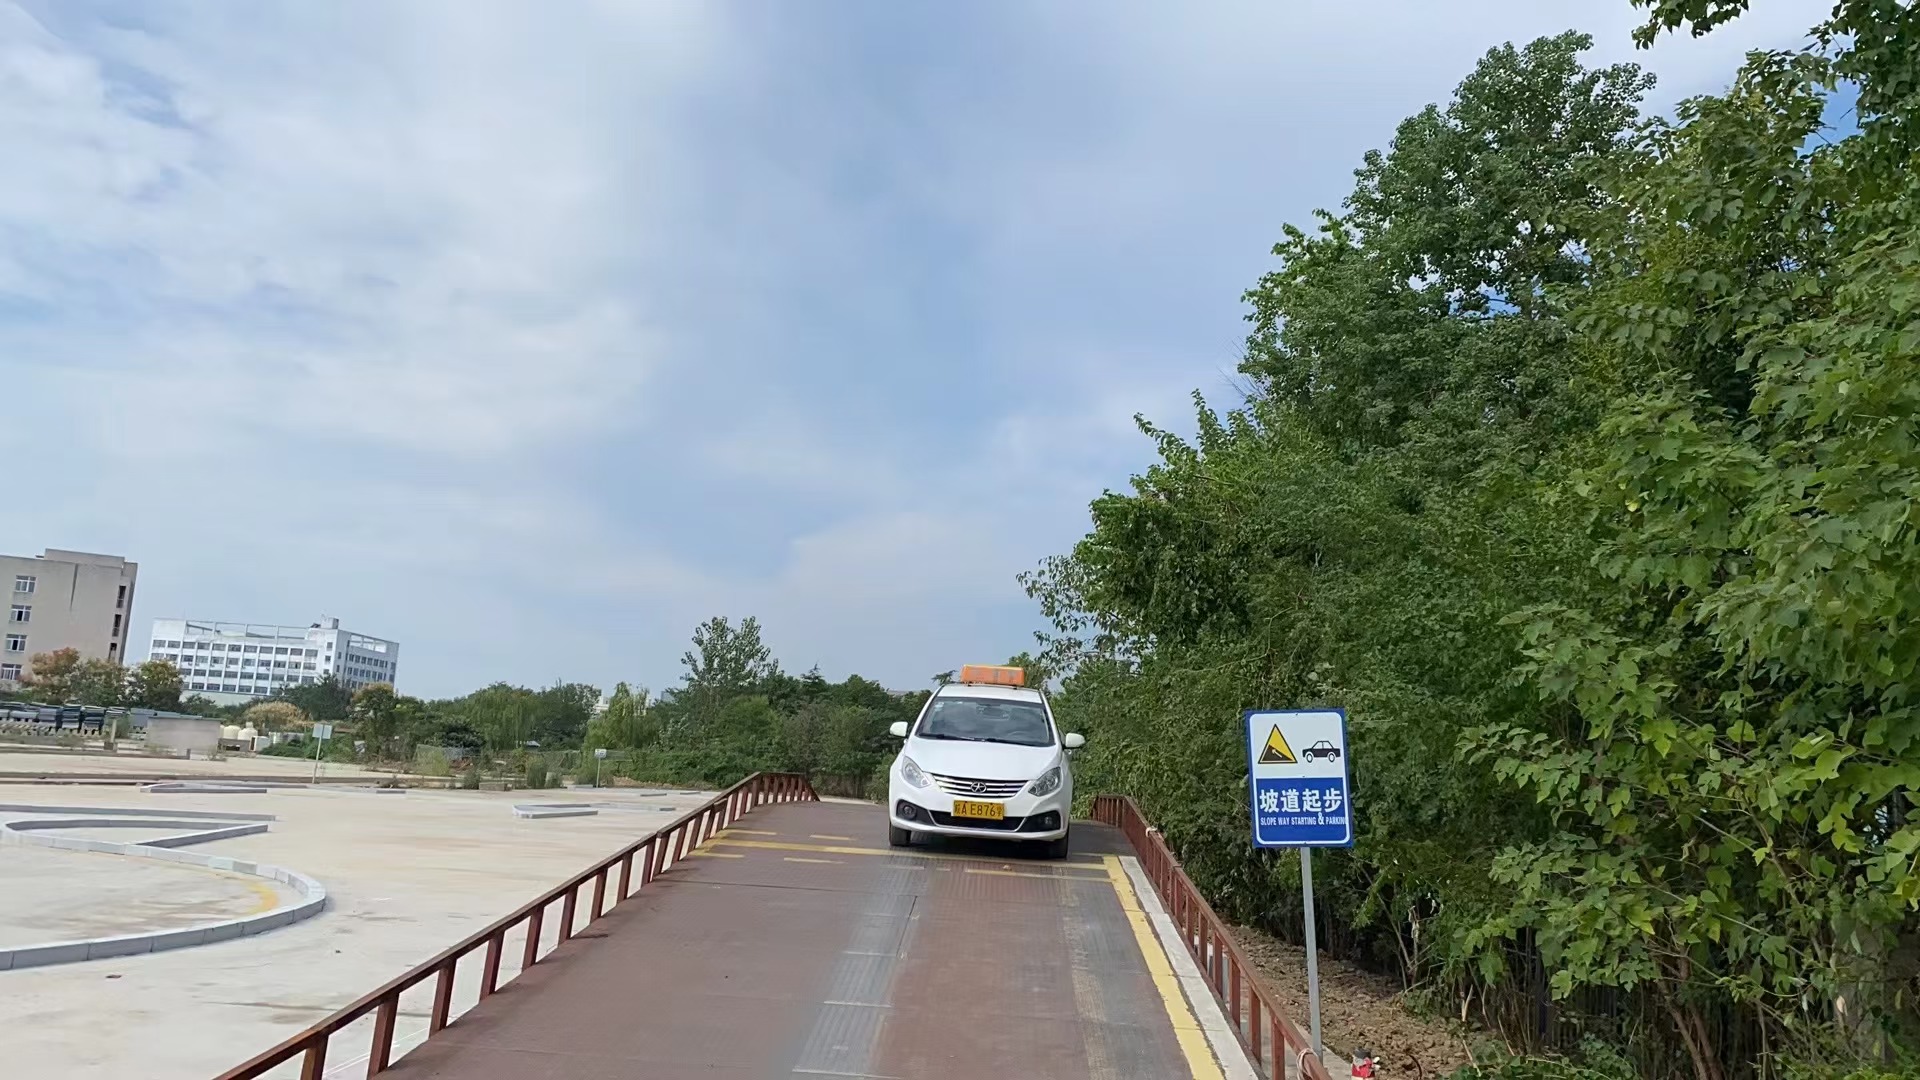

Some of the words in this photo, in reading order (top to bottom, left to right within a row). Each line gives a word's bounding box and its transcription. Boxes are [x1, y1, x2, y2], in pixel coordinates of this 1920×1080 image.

[1259, 788, 1343, 813] 坡道起步
[1260, 817, 1277, 826] SLOPE
[1278, 817, 1290, 826] WAY
[1291, 817, 1317, 826] STARTING
[1318, 812, 1325, 826] &
[1325, 816, 1349, 825] PARKIN
